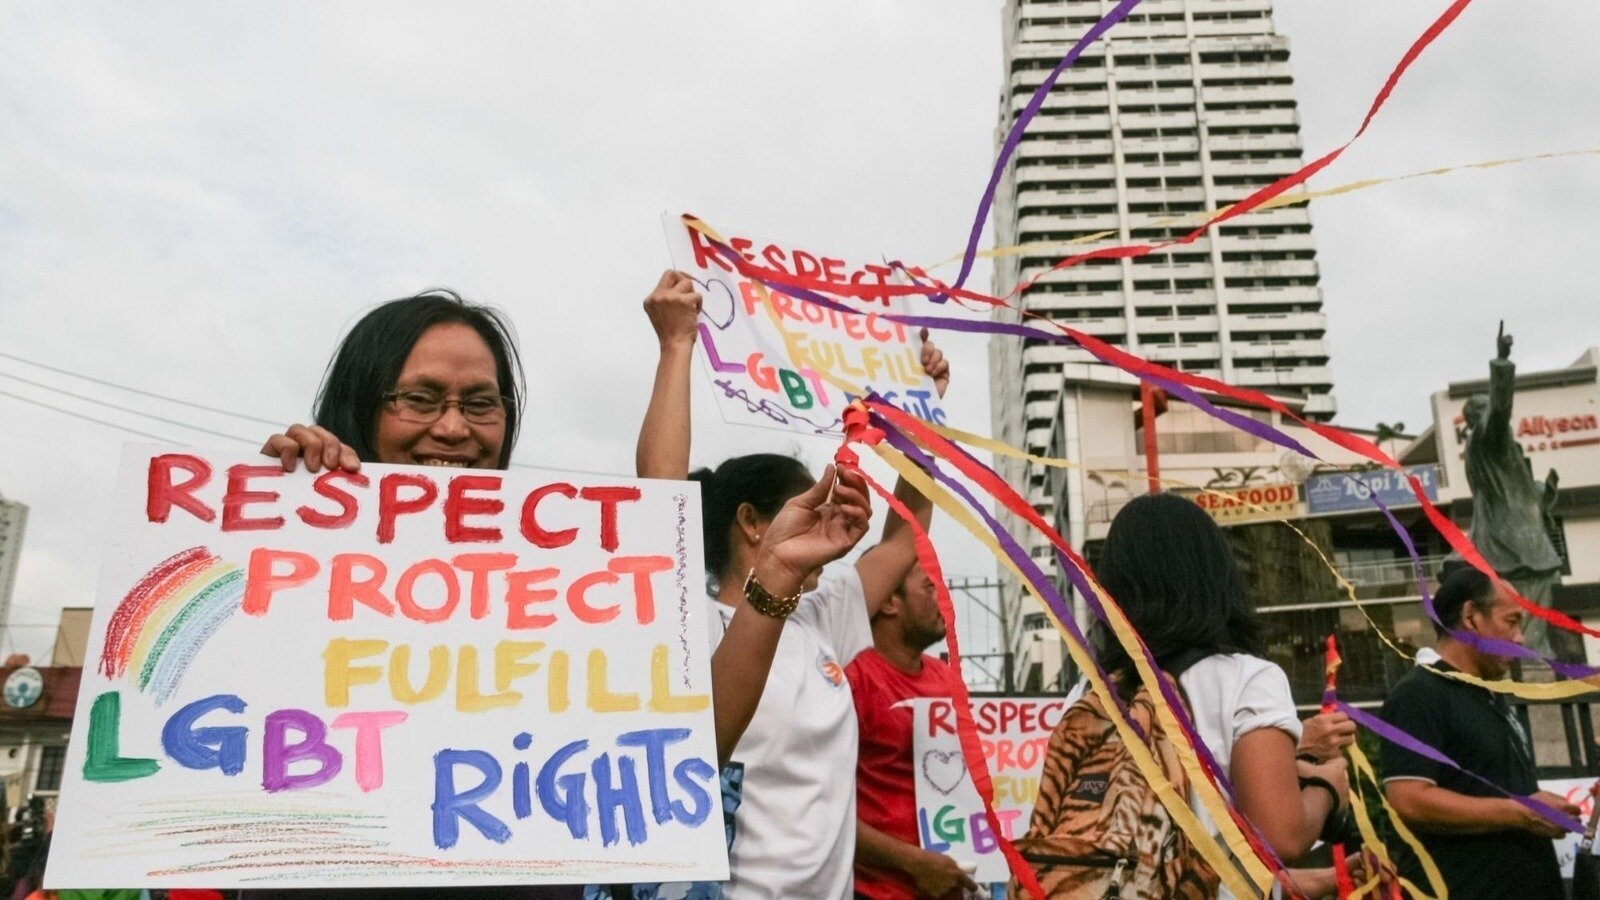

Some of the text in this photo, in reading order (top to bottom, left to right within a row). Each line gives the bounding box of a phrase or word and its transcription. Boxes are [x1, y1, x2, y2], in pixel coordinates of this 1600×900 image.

[697, 322, 830, 410] LGBT
[147, 453, 641, 552] RESPECT
[1196, 484, 1294, 510] SEAFOOD
[242, 547, 675, 630] PROTECT
[322, 636, 710, 714] FULFILL
[82, 690, 409, 793] LGBT
[919, 804, 1022, 855] LGBT
